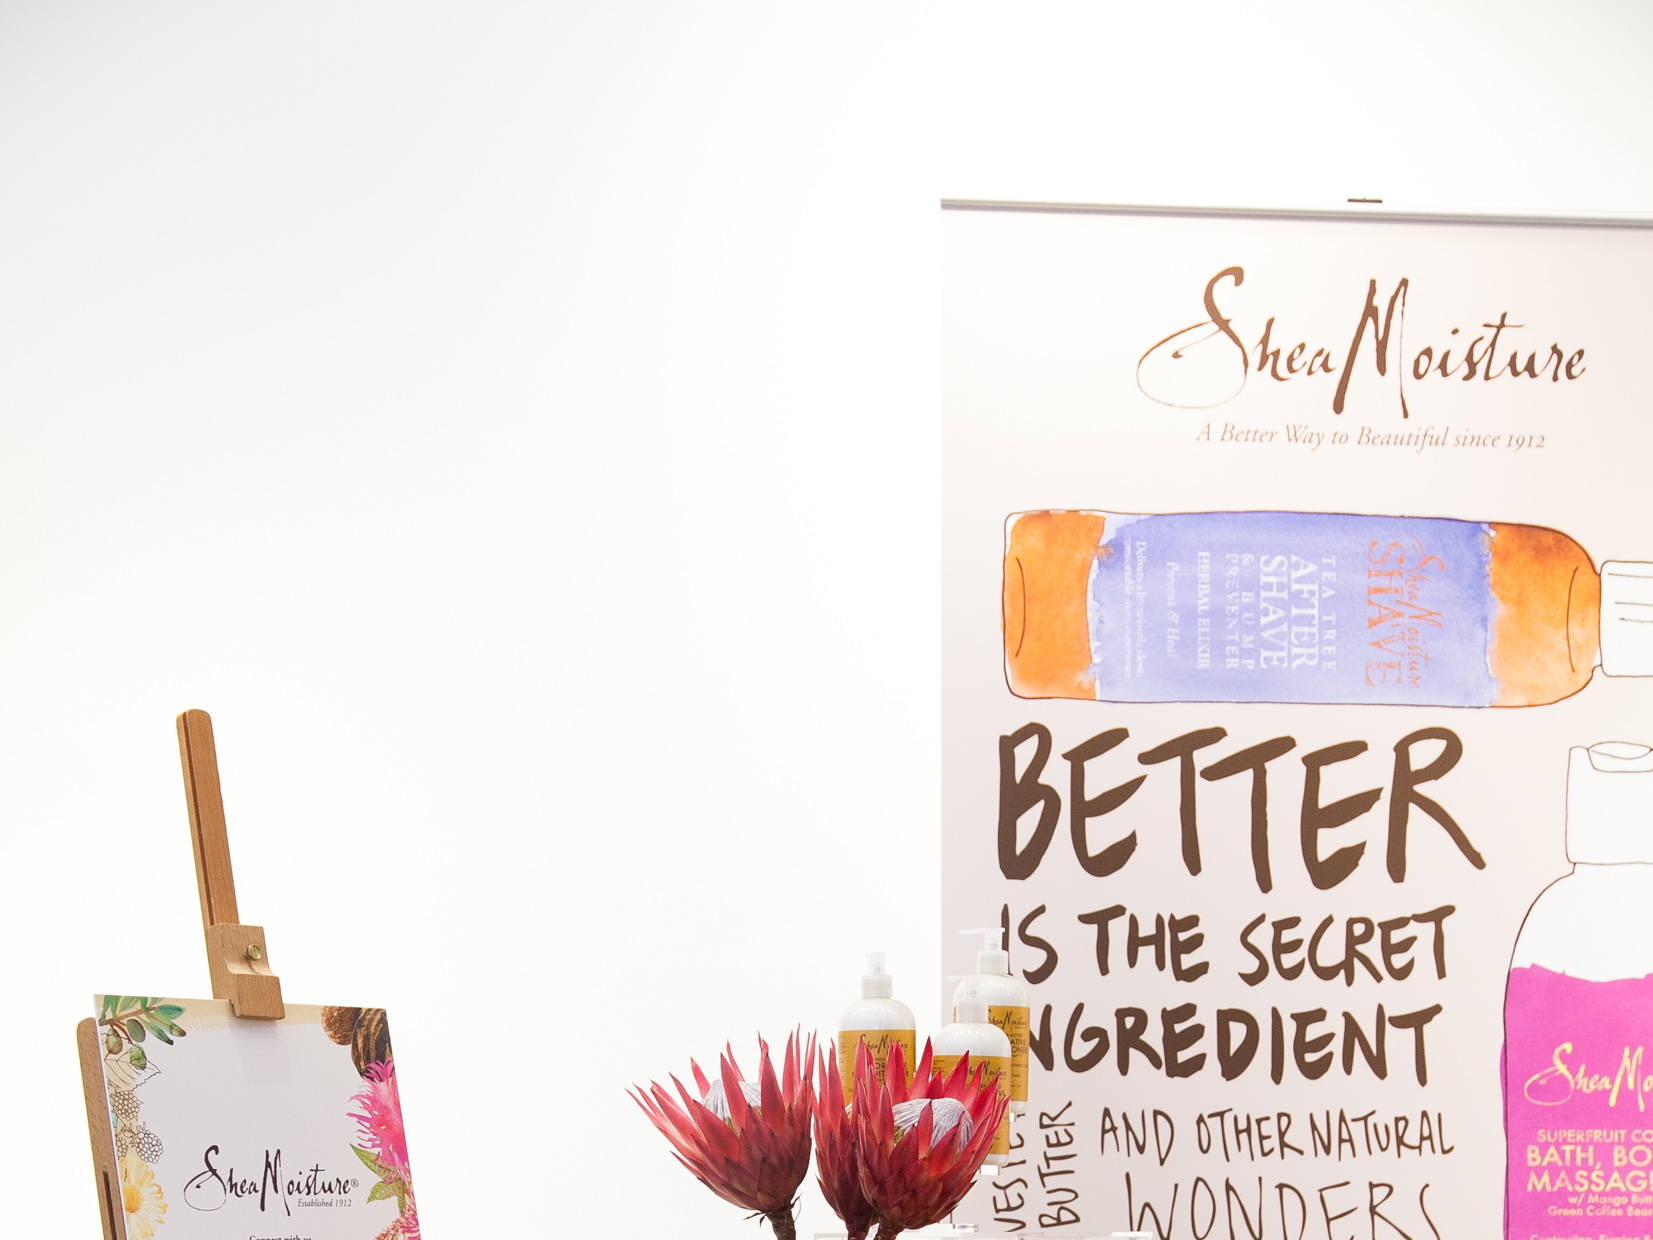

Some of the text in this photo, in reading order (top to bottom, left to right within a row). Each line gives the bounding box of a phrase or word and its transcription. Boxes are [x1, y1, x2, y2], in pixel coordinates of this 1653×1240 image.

[1196, 424, 1546, 453] A Better Way to Beautiful since 1912
[1197, 552, 1210, 669] HERBAL ELIXIR
[1225, 554, 1239, 669] PREVENTER
[1241, 553, 1255, 670] & BUMP
[1259, 555, 1288, 669] SHAVE
[1290, 554, 1319, 671] AFTER
[1322, 555, 1336, 671] TEA TREE
[1364, 539, 1405, 687] SHAVE
[998, 722, 1486, 894] BETTER
[1001, 903, 1456, 987] IS THE SECRET
[1029, 1002, 1443, 1087] NGREDIENT
[1037, 1101, 1080, 1229] BUTTER
[1101, 1106, 1455, 1166] AND OTHER NATURAL
[1526, 1145, 1602, 1170] BATH,
[1537, 1129, 1627, 1143] SUPERFRUIT
[297, 1199, 352, 1208] Established 1912
[1526, 1169, 1653, 1192] MASSAG
[1548, 1206, 1583, 1217] Green
[1586, 1205, 1624, 1217] Coffee
[1588, 1194, 1628, 1207] Mango
